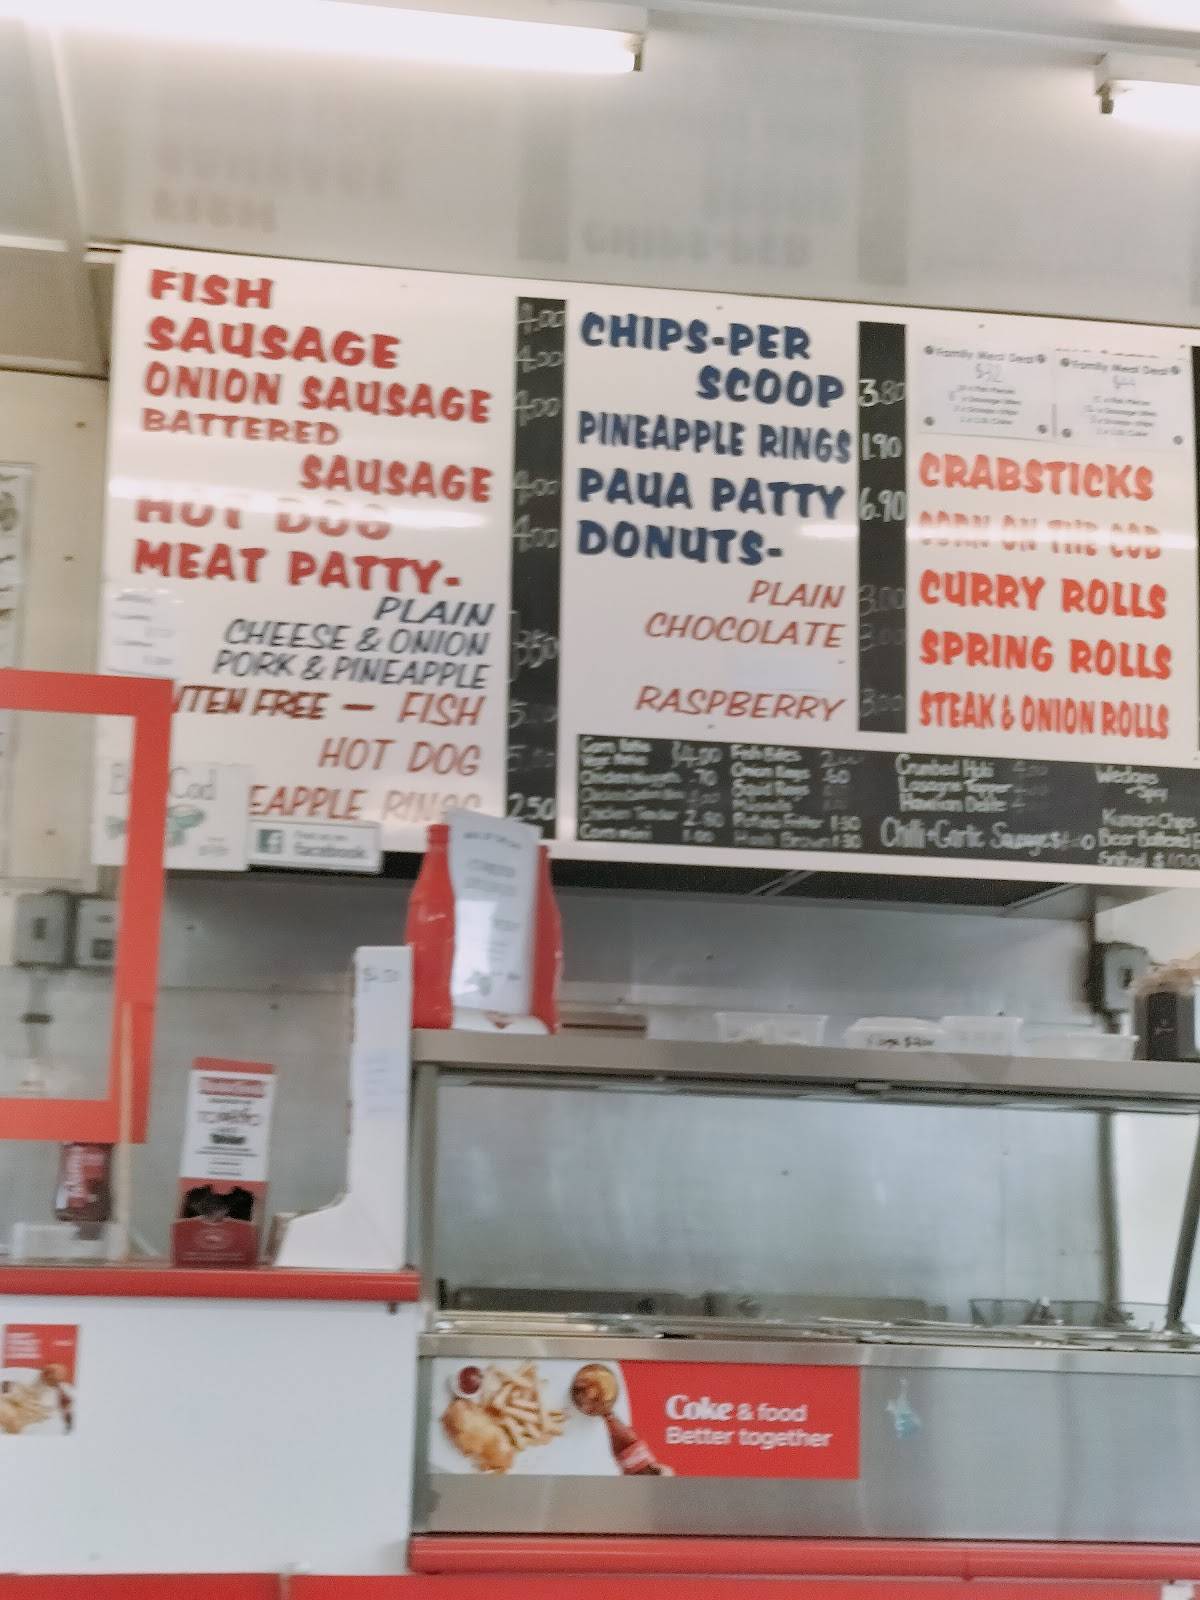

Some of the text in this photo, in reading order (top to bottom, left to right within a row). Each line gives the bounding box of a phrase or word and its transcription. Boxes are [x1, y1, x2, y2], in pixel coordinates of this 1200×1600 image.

[148, 268, 275, 309] FISH
[144, 316, 401, 369] SAUSAGE
[580, 312, 811, 360] CHIPS-PER
[144, 361, 494, 424] ONION SAUSAGE
[697, 364, 846, 408] SCOOP
[141, 408, 340, 446] BATTERED
[577, 410, 852, 464] PINEAPPLE RINGS
[300, 453, 494, 503] SAUSAGE
[577, 467, 846, 520] PAUA PATTY
[918, 452, 1155, 502] CRABSTICKS
[577, 519, 783, 566] DONUTS-
[133, 538, 461, 595] MEAT PATTY-
[375, 596, 495, 627] PLAIN
[747, 579, 847, 610] PLAIN
[918, 568, 1168, 620] CURRY ROLLS
[223, 618, 491, 657] CHEESE & ONION
[643, 611, 847, 649] CHOCOLATE
[212, 648, 493, 690] PORK & PINEAPPLE
[919, 627, 1173, 681] SPRING ROLLS
[252, 688, 331, 720] FREE
[397, 691, 486, 727] FISH
[633, 684, 847, 722] RASPBERRY
[919, 689, 995, 730] STEAK
[1020, 694, 1096, 736] ONION
[1101, 700, 1170, 741] ROLLS
[317, 738, 395, 769] HOT
[407, 743, 482, 776] DOG
[664, 1393, 808, 1422] Coke & food
[665, 1426, 833, 1450] Better together
